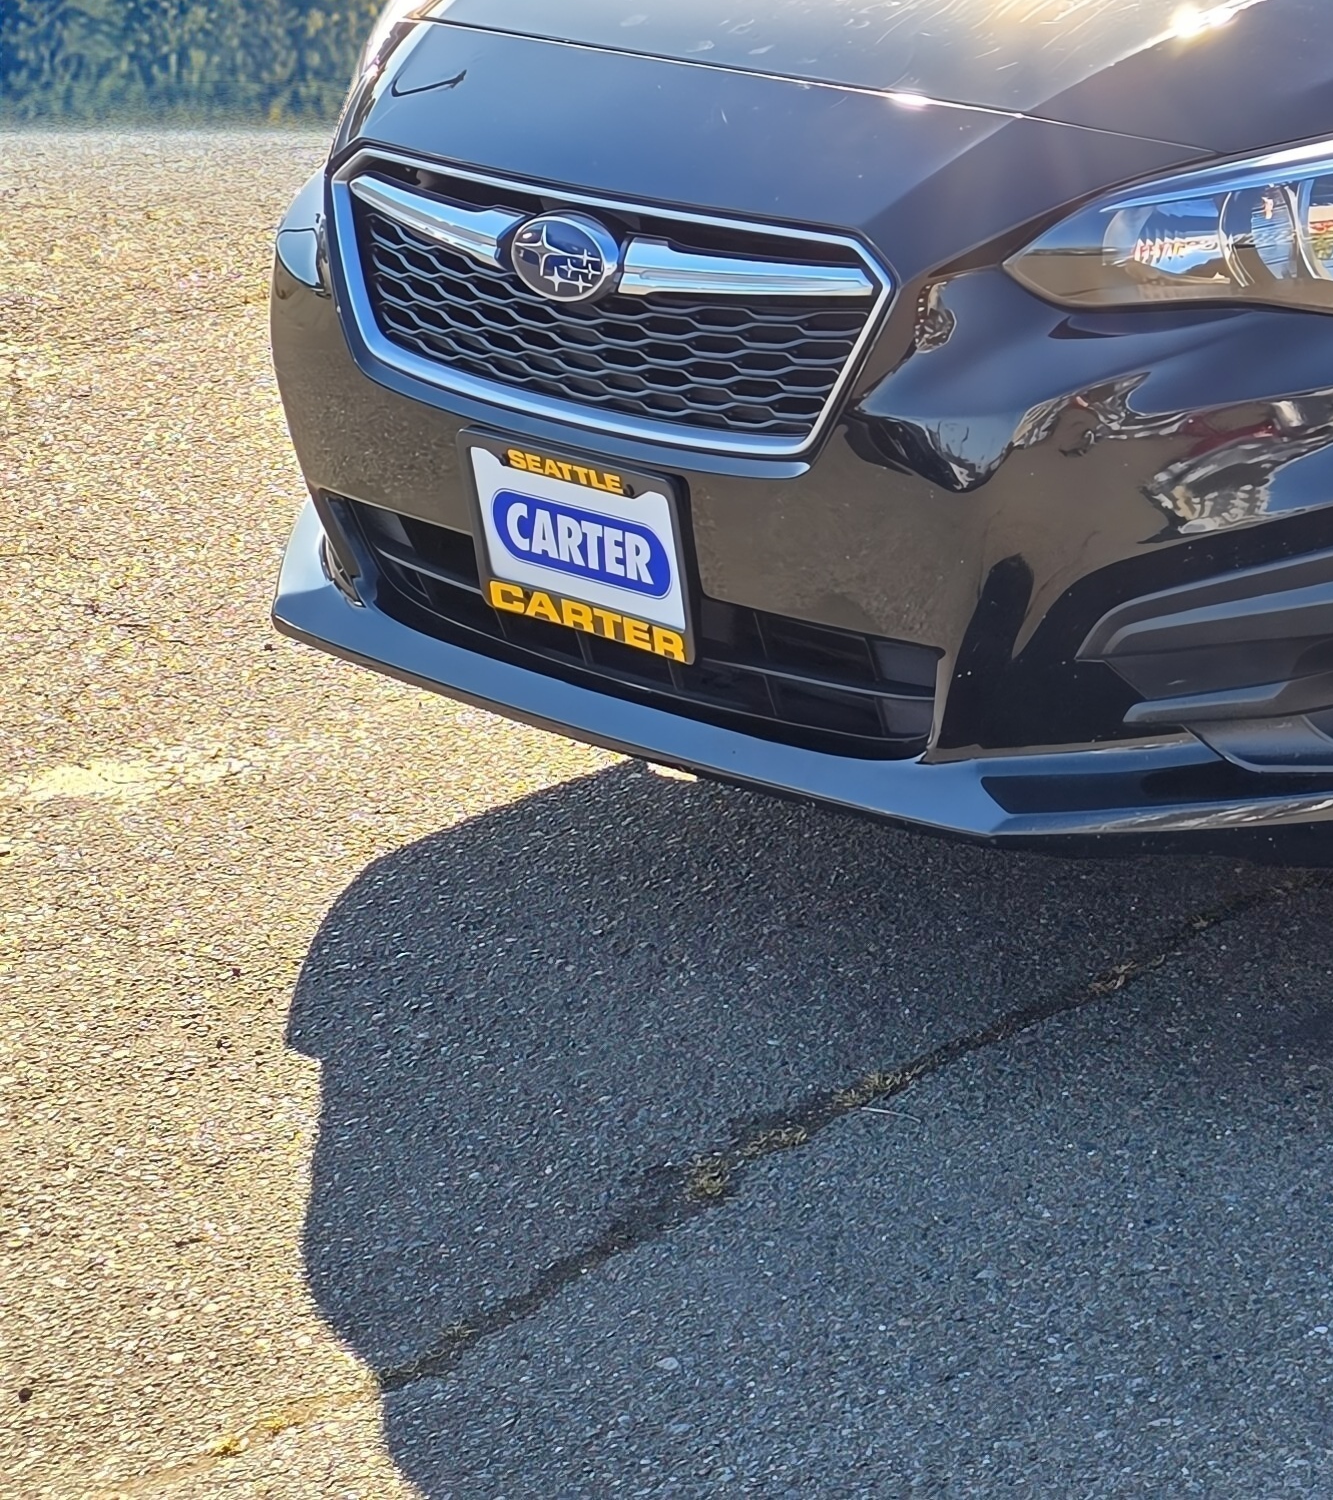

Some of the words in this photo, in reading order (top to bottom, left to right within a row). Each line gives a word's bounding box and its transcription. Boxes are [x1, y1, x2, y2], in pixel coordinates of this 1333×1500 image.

[507, 449, 624, 494] SEATTLE
[506, 502, 655, 585] CARTER
[489, 580, 686, 662] CARTER
